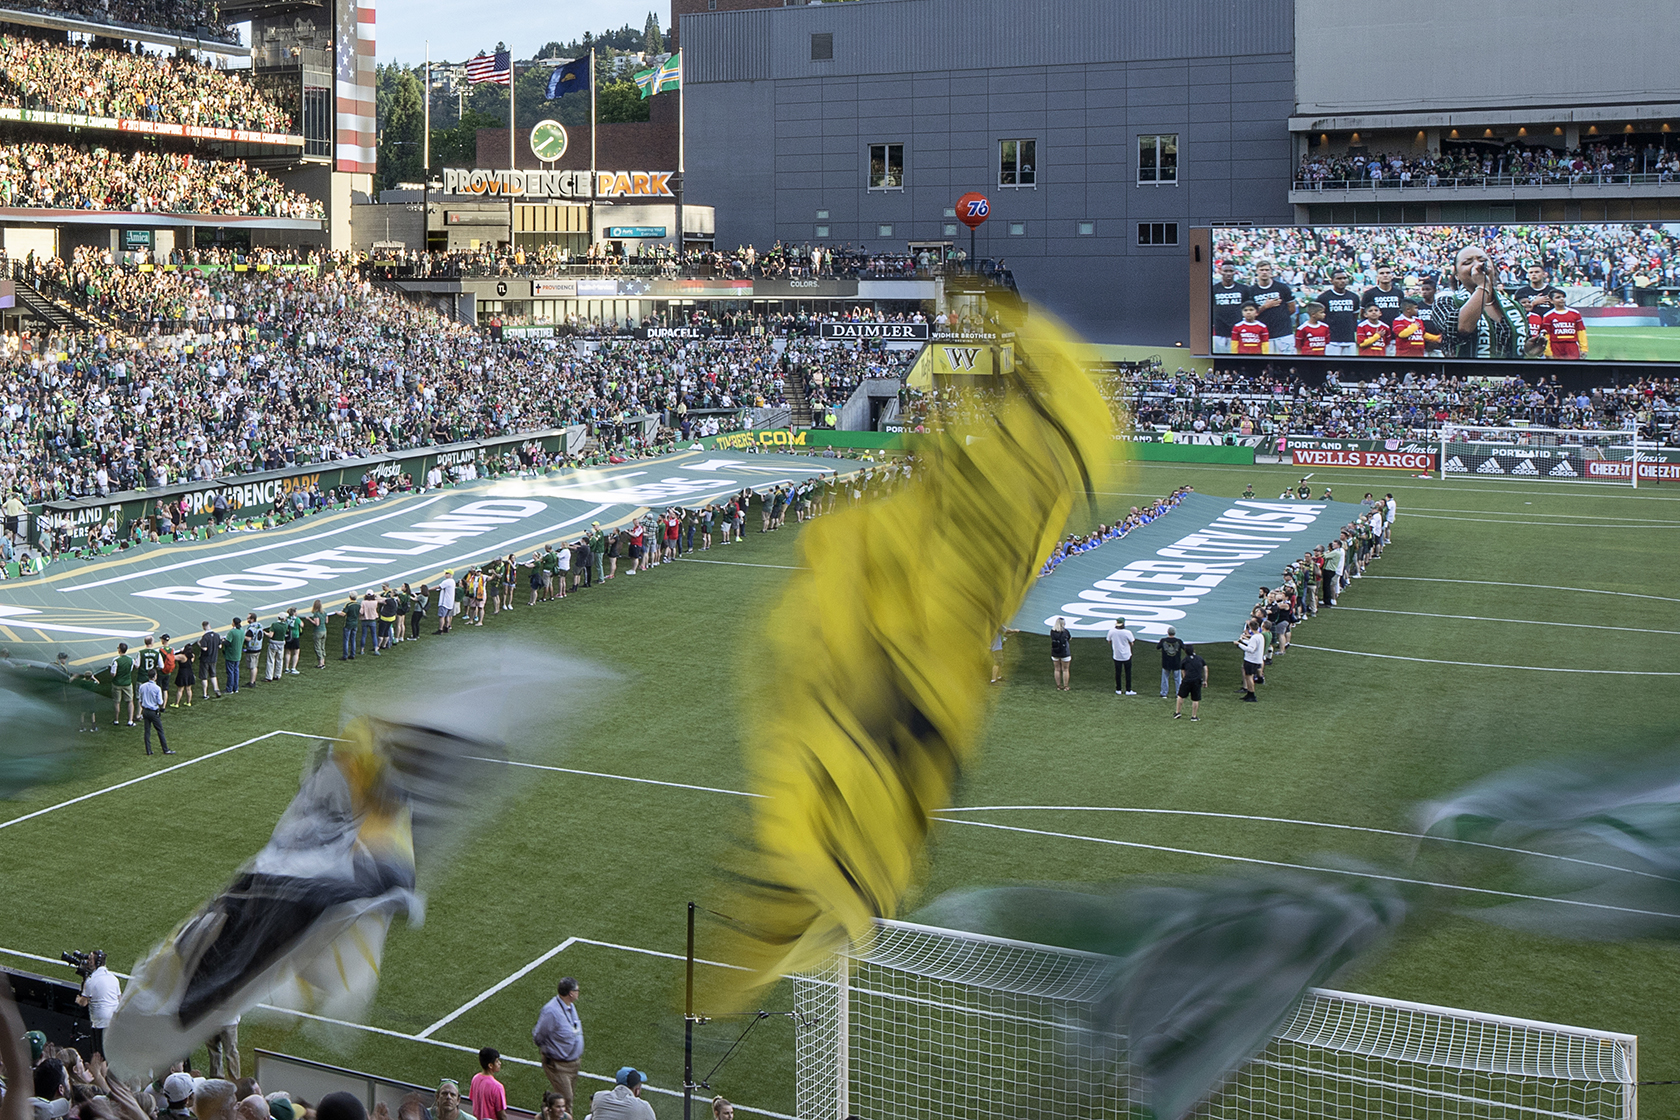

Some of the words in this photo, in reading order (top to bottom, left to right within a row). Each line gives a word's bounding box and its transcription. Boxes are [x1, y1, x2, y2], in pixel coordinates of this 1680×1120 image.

[443, 167, 592, 197] PROVIDENCE
[595, 171, 677, 198] PARK
[968, 200, 988, 216] 76
[127, 230, 149, 242] Amica
[498, 283, 506, 292] TL
[1215, 292, 1242, 300] SOCCER
[1329, 299, 1353, 307] SOCCER
[647, 328, 700, 338] DURACELL
[833, 325, 916, 337] DAIMLER
[942, 346, 984, 372] W
[886, 426, 931, 434] PORTLD
[716, 431, 806, 450] TIMBERS.COM
[1287, 440, 1342, 450] PORTAND
[1398, 443, 1439, 454] Alaska
[437, 451, 476, 466] PORTLAND
[1295, 450, 1361, 465] WELLS
[1365, 453, 1431, 469] FARGO
[1624, 452, 1668, 463] Alaska
[371, 462, 402, 478] Alaska
[1476, 465, 1505, 474] adidas
[1511, 467, 1539, 476] adidas
[1548, 469, 1578, 478] adidas
[1208, 499, 1327, 534] USA
[130, 499, 549, 604] PORTLAND
[1156, 532, 1292, 561] CITY
[1043, 560, 1244, 636] SOCCER
[145, 658, 154, 670] 13
